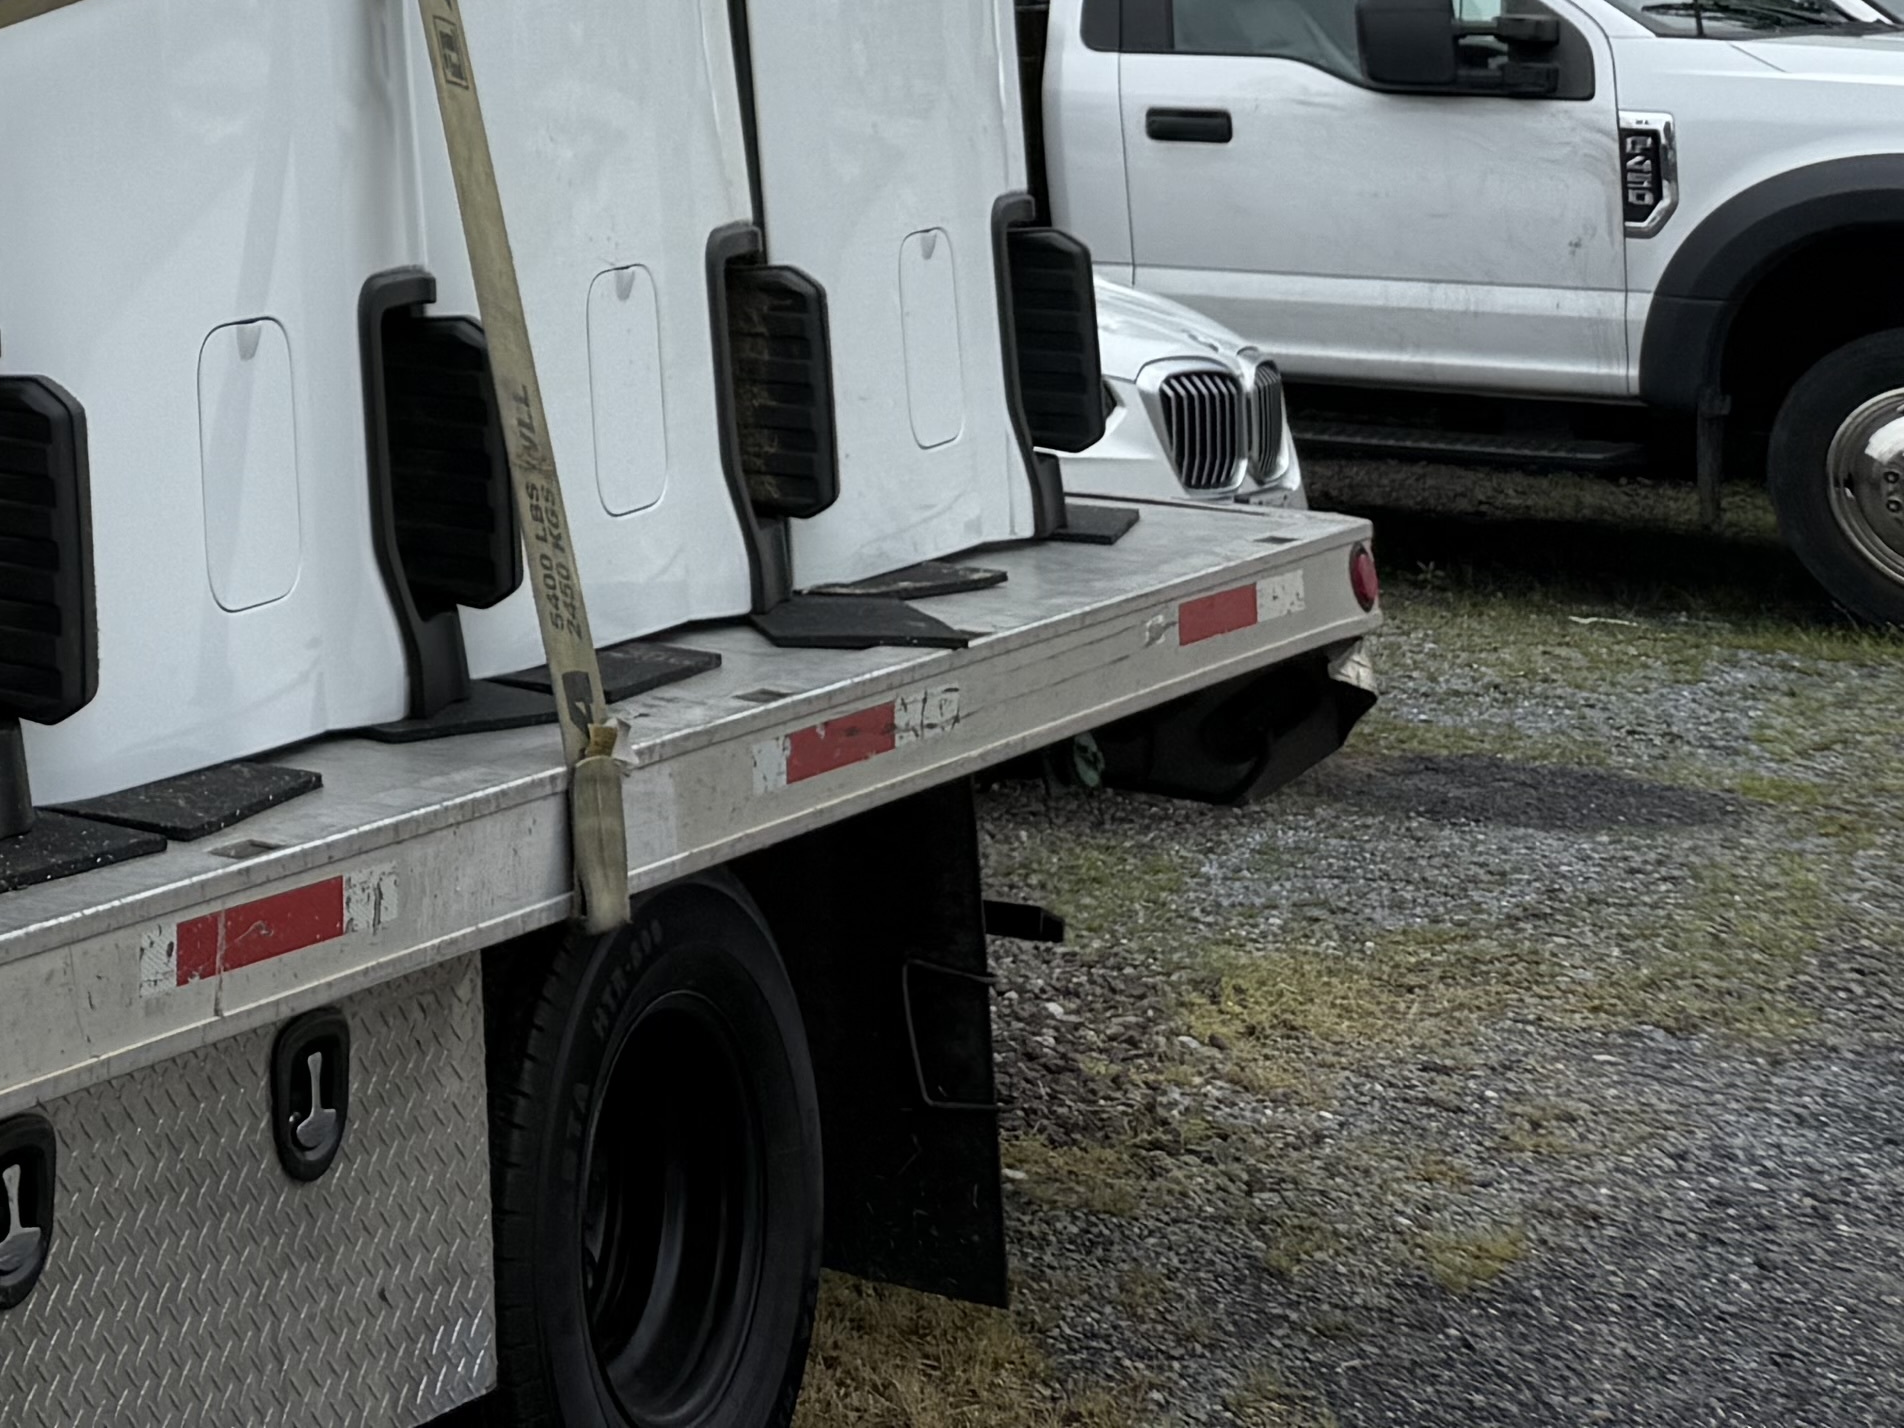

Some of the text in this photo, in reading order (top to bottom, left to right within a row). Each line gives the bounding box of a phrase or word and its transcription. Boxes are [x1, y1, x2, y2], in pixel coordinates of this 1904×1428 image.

[526, 482, 565, 630] 5400 LBS
[544, 487, 569, 555] KGS
[554, 562, 583, 640] 2450
